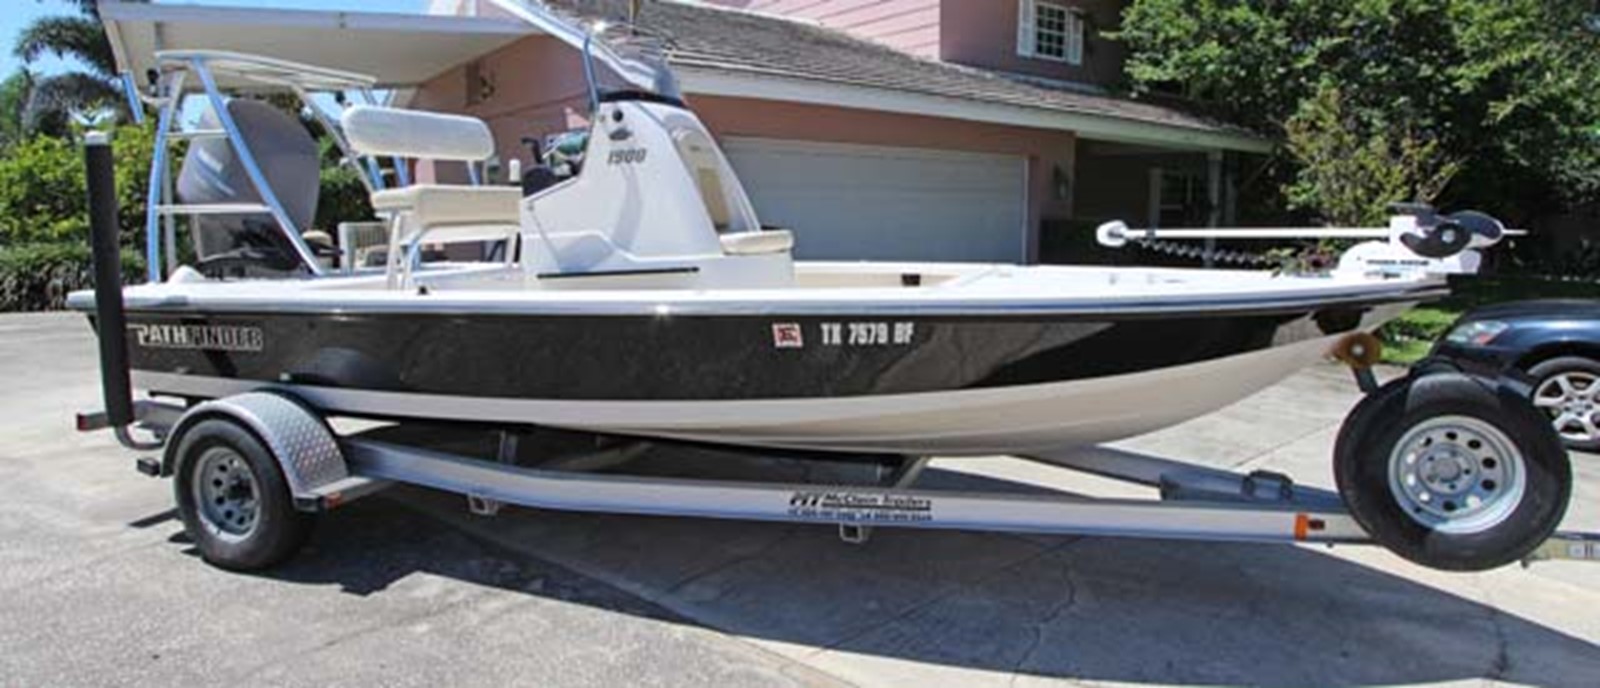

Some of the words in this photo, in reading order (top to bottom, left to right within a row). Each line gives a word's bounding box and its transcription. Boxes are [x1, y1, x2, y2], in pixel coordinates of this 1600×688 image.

[607, 148, 647, 166] 1900
[126, 323, 263, 350] PATHFINDER
[820, 322, 842, 345] TX
[848, 322, 888, 345] 7579
